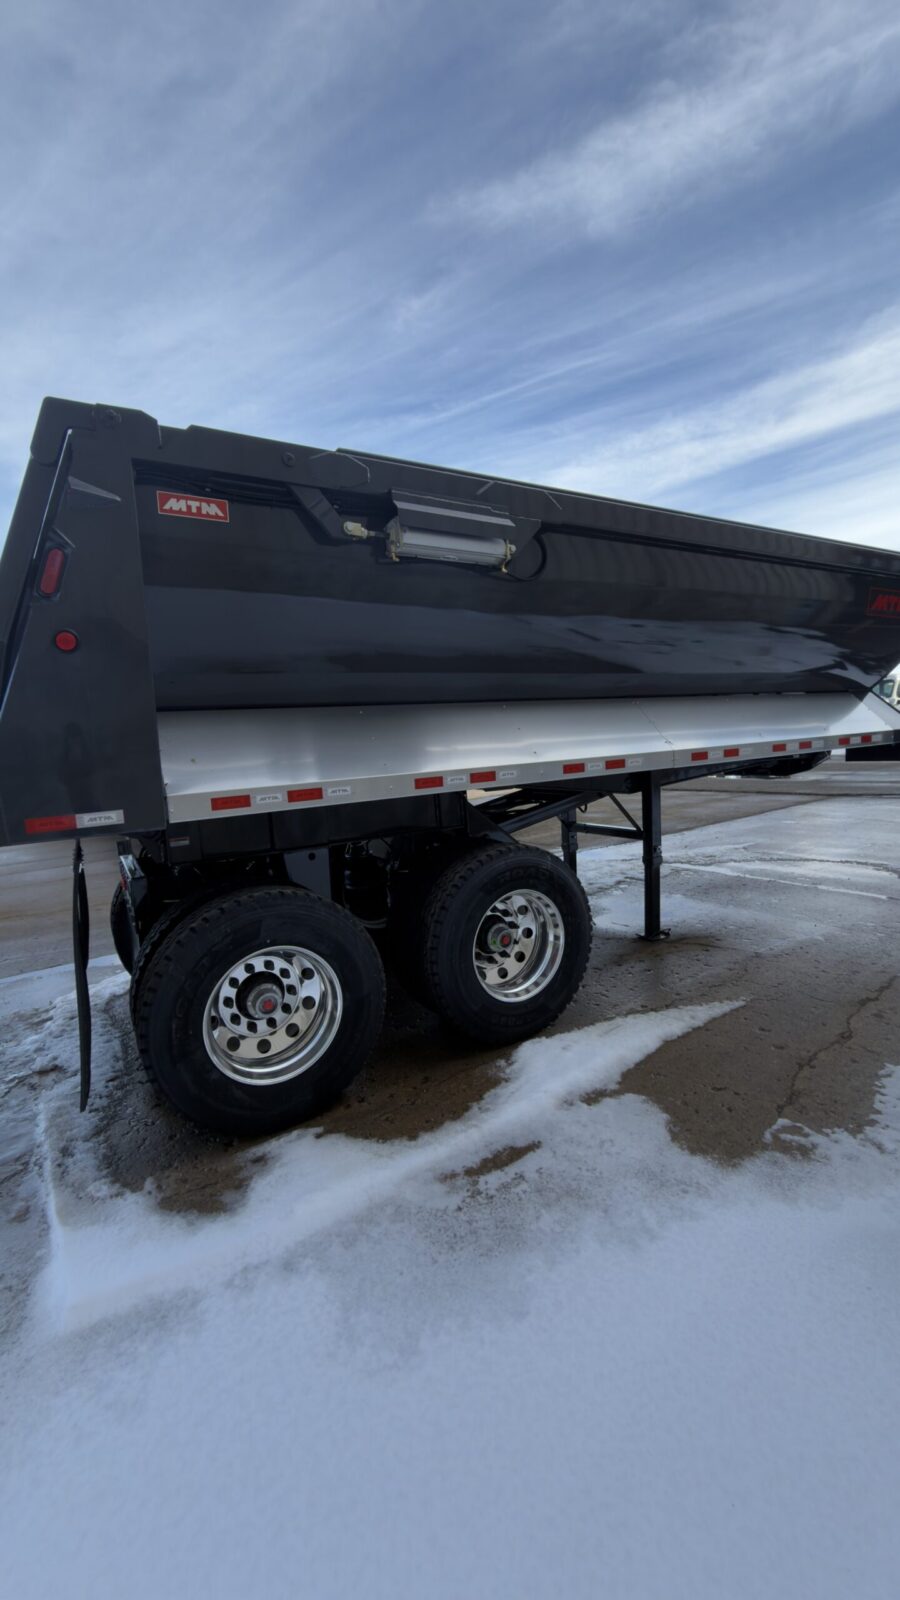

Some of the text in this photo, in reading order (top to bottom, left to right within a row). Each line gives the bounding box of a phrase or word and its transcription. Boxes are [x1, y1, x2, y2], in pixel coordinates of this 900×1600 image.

[163, 498, 224, 516] MTM
[870, 594, 900, 611] MT
[87, 815, 115, 823] MTM
